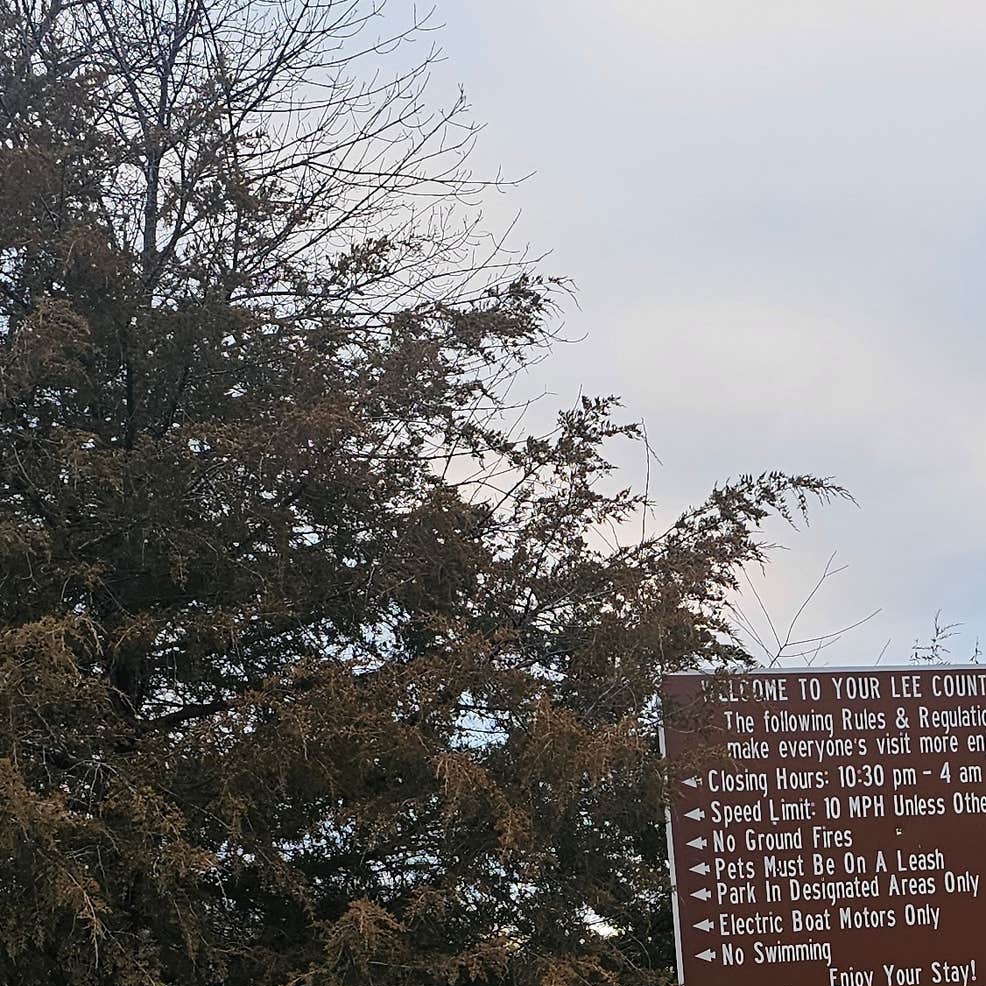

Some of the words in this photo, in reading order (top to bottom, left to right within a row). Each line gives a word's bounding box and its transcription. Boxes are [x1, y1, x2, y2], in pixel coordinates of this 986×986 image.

[798, 678, 821, 700] TO
[832, 677, 881, 700] YOUR
[891, 675, 922, 698] LEE
[724, 711, 754, 733] The
[764, 709, 833, 737] following
[842, 707, 886, 731] Rules
[896, 707, 910, 730] &
[727, 737, 769, 759] make
[779, 737, 867, 763] everyone's
[877, 730, 911, 755] visit
[920, 733, 959, 754] more
[708, 768, 768, 797] Closing
[776, 767, 830, 790] Hours:
[838, 764, 885, 788] 10:30
[893, 767, 917, 791] pm
[939, 761, 951, 784] 4
[959, 765, 983, 783] am
[710, 800, 762, 828] Speed
[769, 798, 816, 822] Limit:
[824, 797, 841, 820] 10
[848, 795, 885, 819] MPH
[894, 794, 946, 817] Unless
[713, 829, 736, 853] No
[745, 827, 803, 851] Ground
[812, 826, 853, 849] Fires
[715, 857, 755, 880] Pets
[763, 855, 805, 878] Must
[812, 853, 835, 876] Be
[843, 851, 867, 874] On
[875, 850, 887, 873] A
[897, 848, 945, 872] Leash
[717, 882, 756, 905] Park
[765, 880, 782, 903] In
[789, 876, 880, 906] Designated
[888, 874, 936, 897] Areas
[944, 871, 980, 898] Only
[719, 912, 784, 936] Electric
[792, 909, 831, 932] Boat
[840, 906, 896, 930] Motors
[904, 903, 940, 930] Only
[721, 943, 744, 966] No
[753, 939, 832, 966] Swimming
[883, 963, 922, 986] Your
[931, 959, 977, 986] Stay!
